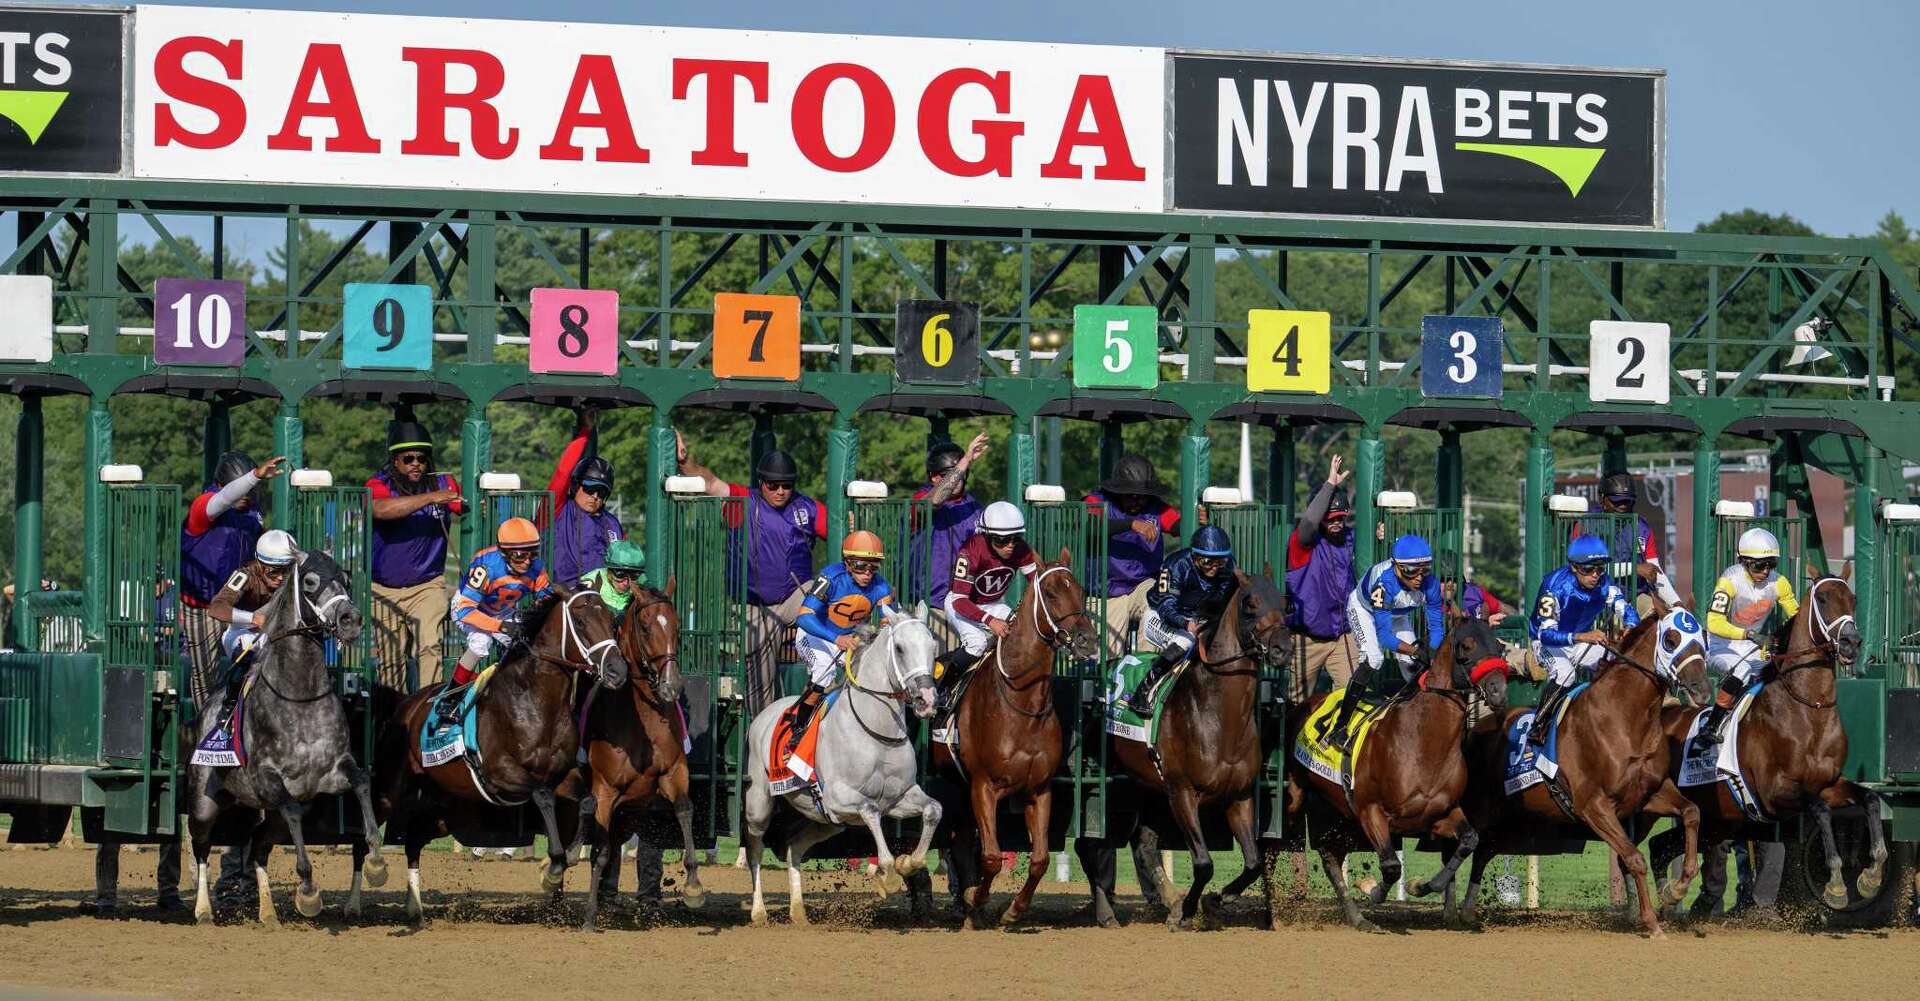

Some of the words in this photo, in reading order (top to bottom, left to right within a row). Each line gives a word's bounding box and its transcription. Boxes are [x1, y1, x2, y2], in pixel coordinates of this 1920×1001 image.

[154, 36, 1146, 182] SARATOGA
[1218, 77, 1443, 193] NYRA
[1455, 88, 1608, 143] BETS
[171, 293, 231, 349] 10
[373, 298, 405, 352] 9
[557, 304, 589, 358] 8
[743, 309, 774, 362] 7
[921, 313, 954, 368] 6
[1102, 319, 1133, 373] 5
[1272, 325, 1302, 377] 4
[1446, 331, 1478, 384] 3
[1616, 337, 1645, 388] 2
[469, 565, 487, 588] 9
[813, 576, 828, 595] 7
[955, 557, 968, 578] 6
[984, 572, 1012, 593] W
[1158, 572, 1168, 593] 5
[1370, 587, 1384, 608] 4
[1539, 596, 1555, 617] 3
[1711, 592, 1729, 613] 2
[197, 753, 215, 763] POST
[214, 753, 234, 764] TIME
[1509, 713, 1535, 766] 3
